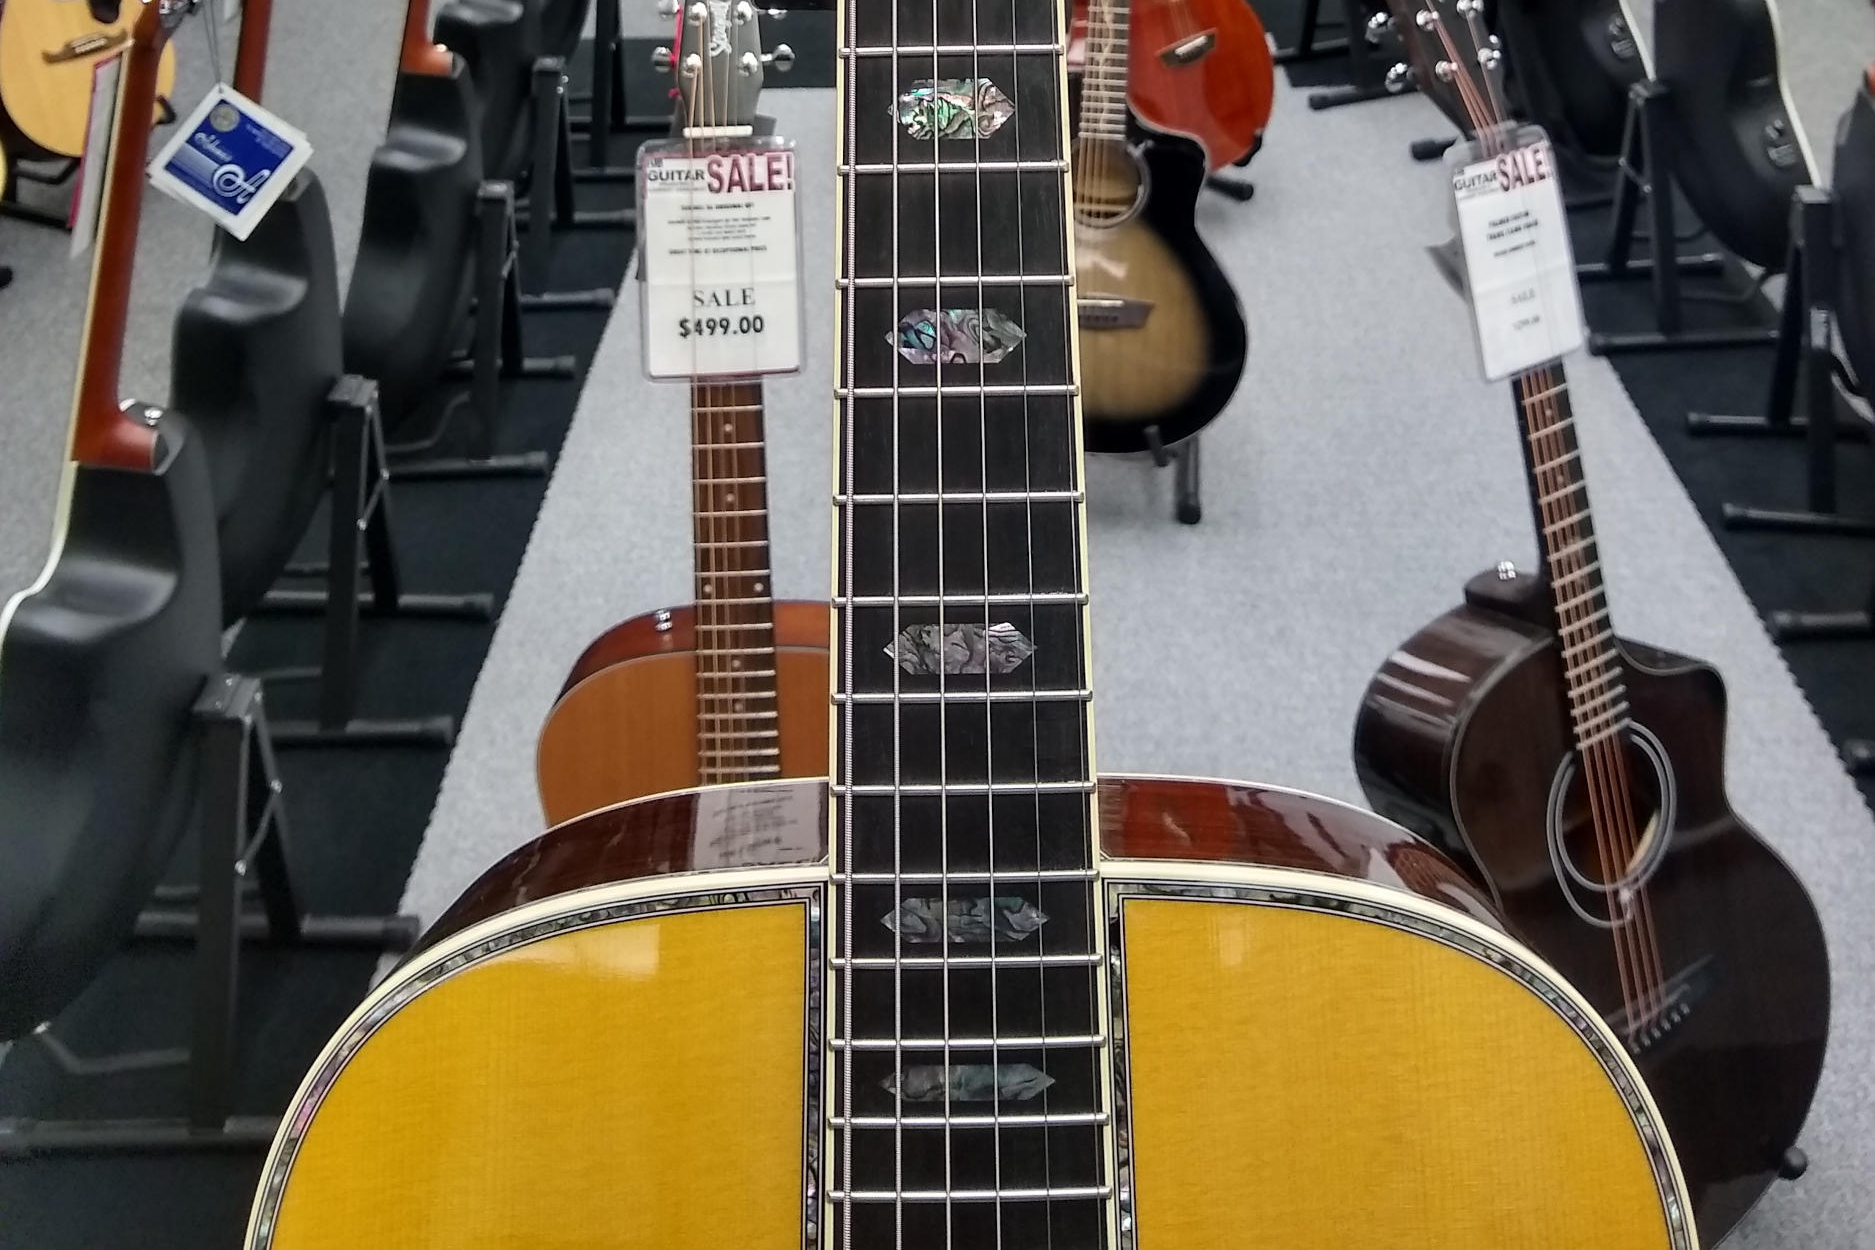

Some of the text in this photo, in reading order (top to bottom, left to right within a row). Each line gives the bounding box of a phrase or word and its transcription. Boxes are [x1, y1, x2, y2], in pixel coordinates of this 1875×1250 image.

[647, 169, 705, 181] GUITAR
[707, 153, 793, 194] SALE!
[693, 286, 756, 308] SALE
[679, 315, 764, 339] $499.00
